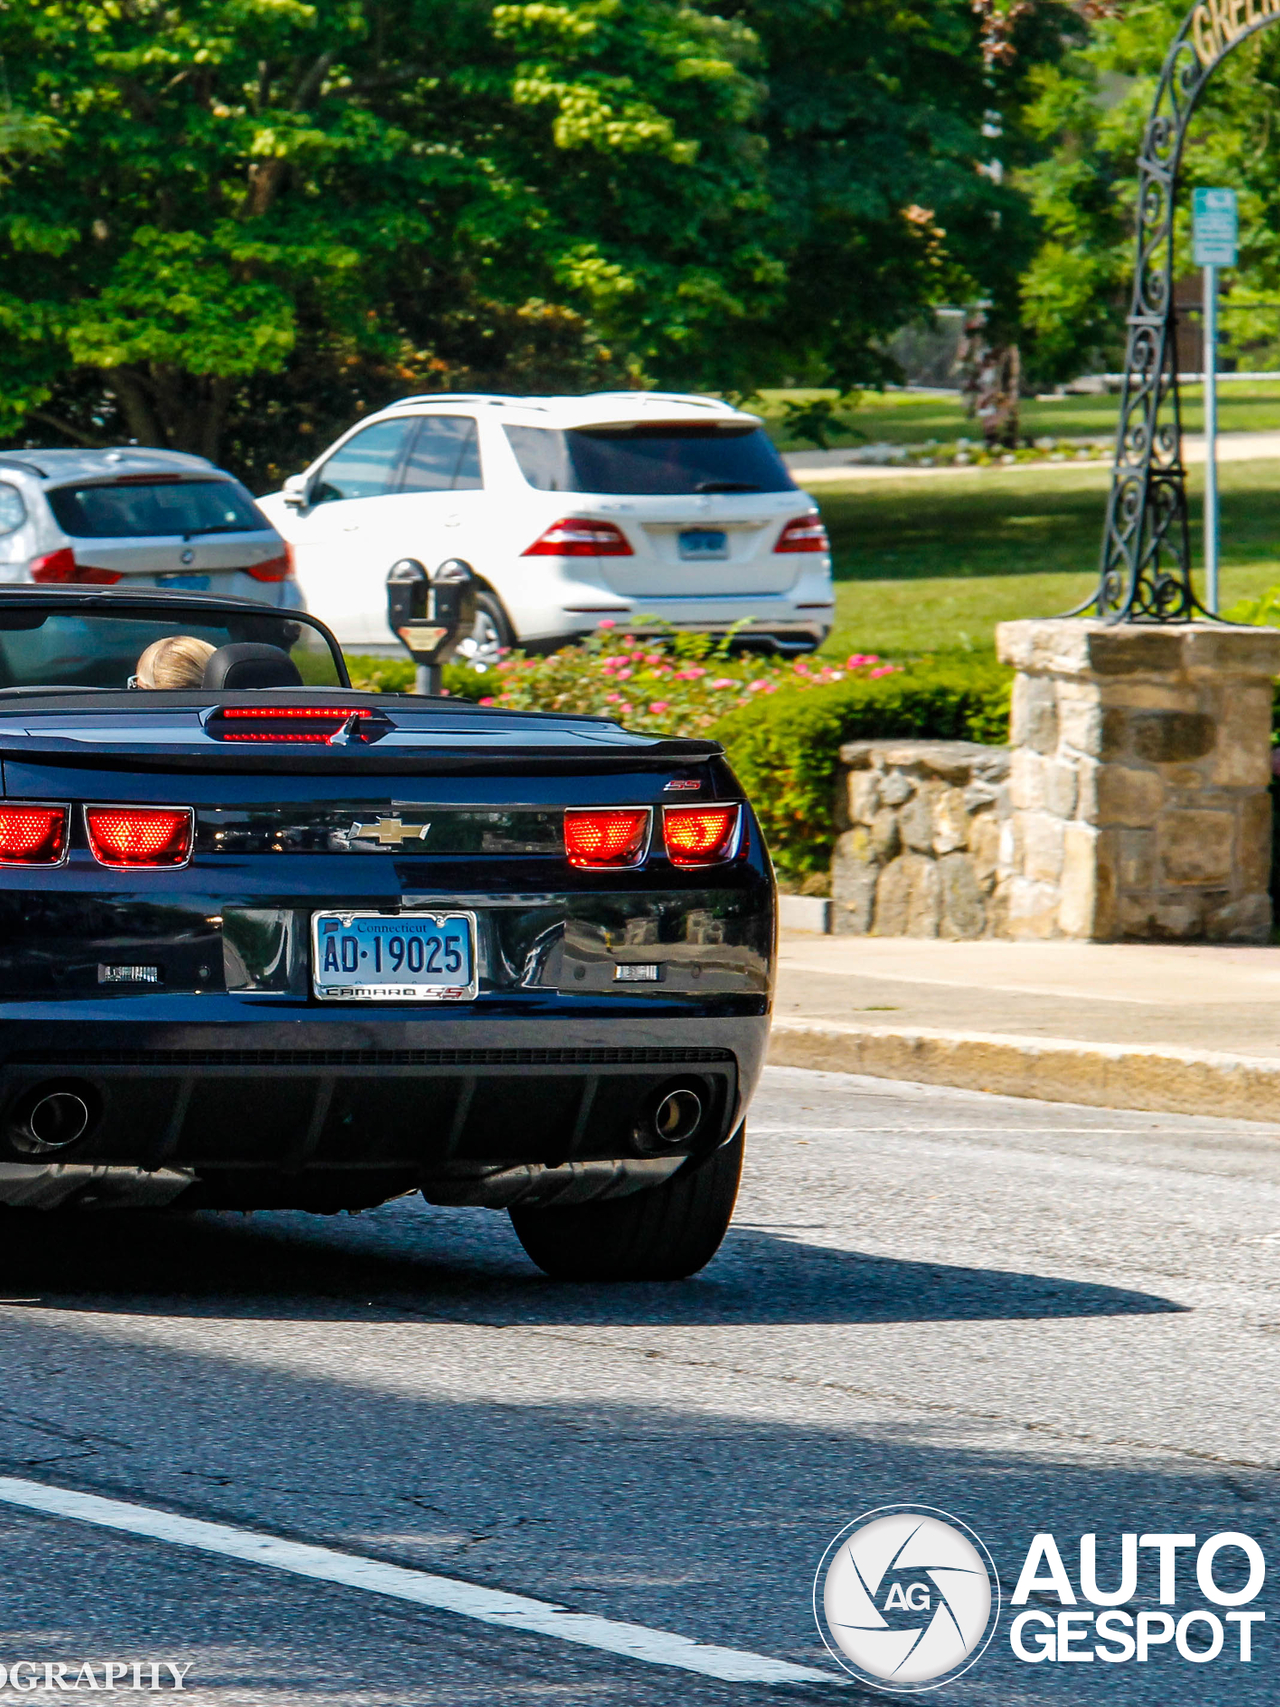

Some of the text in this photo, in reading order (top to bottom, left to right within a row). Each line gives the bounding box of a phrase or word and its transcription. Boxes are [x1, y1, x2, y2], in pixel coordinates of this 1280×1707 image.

[663, 780, 701, 791] SS
[357, 922, 427, 933] Connecticut
[326, 987, 465, 998] CAMARO SS
